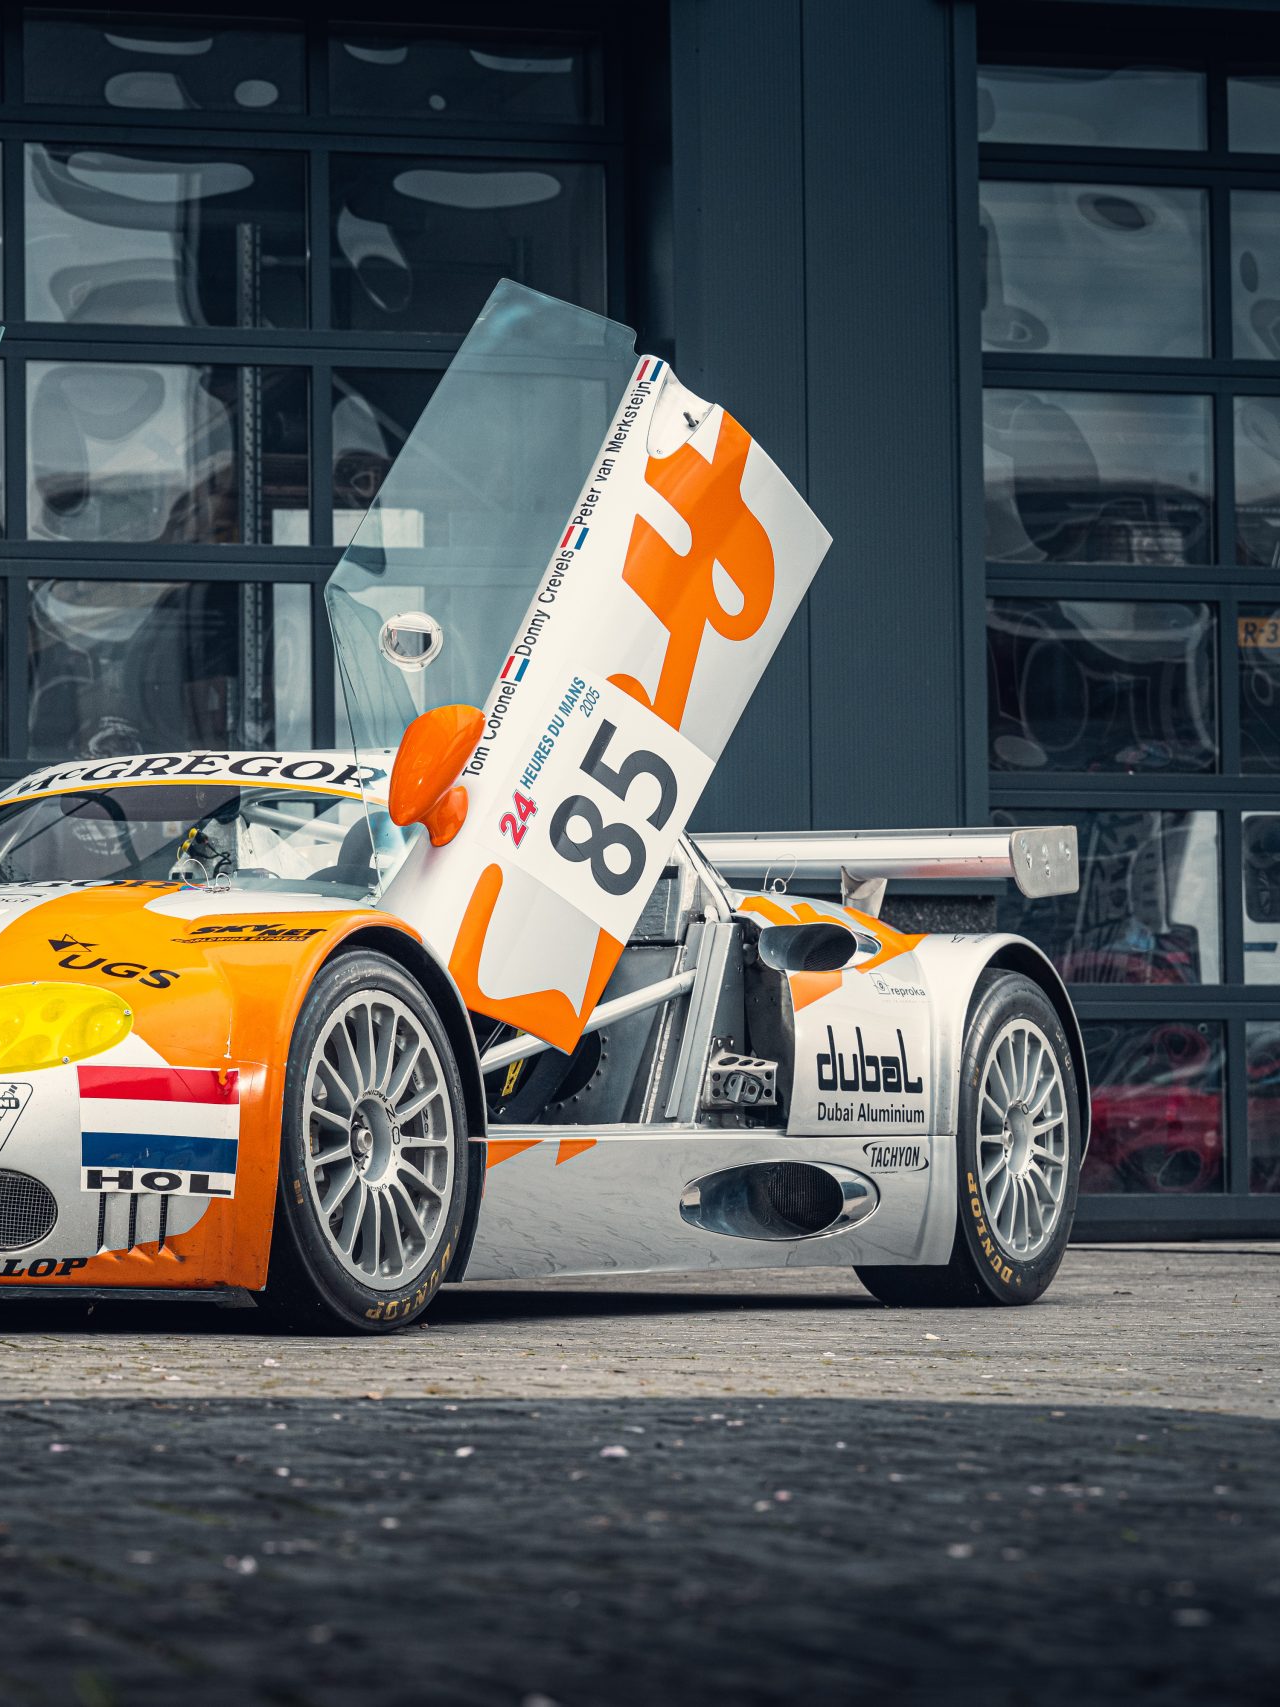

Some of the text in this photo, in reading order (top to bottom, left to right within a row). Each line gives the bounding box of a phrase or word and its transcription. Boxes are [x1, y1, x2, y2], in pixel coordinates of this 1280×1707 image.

[572, 381, 652, 526] Peter van Merksteijn
[514, 549, 575, 657] Donny Crevels
[462, 680, 518, 776] Tom Coronel
[579, 686, 601, 718] 2005
[498, 676, 586, 850] 24 HEURES DU MANS
[549, 718, 678, 896] 85
[58, 954, 181, 989] UGS
[890, 985, 926, 997] reproka
[818, 1102, 925, 1123] Dubai Aluminium
[86, 1170, 232, 1195] HOL
[871, 1147, 920, 1167] TACHYON
[967, 1172, 1011, 1285] DUNLOP
